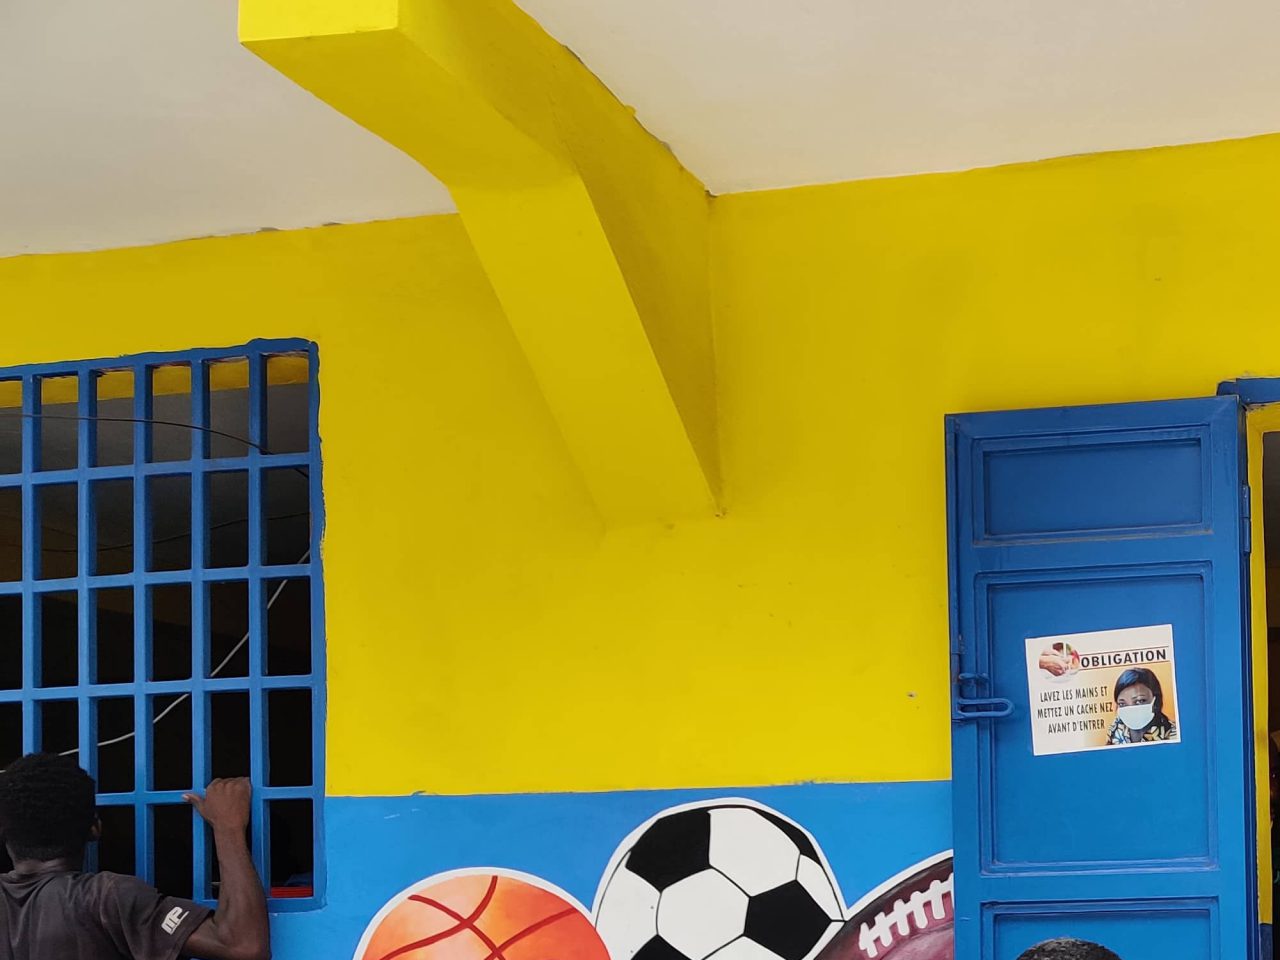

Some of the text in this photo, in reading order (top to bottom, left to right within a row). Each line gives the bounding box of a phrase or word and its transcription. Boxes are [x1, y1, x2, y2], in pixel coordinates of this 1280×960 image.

[1081, 649, 1167, 668] OBLIGATION
[1039, 685, 1108, 703] LAVEZ LES MAINS ET
[1037, 701, 1114, 719] METTEZ UN CACHE NEZ
[1048, 718, 1105, 734] AVANT D'ENTRER
